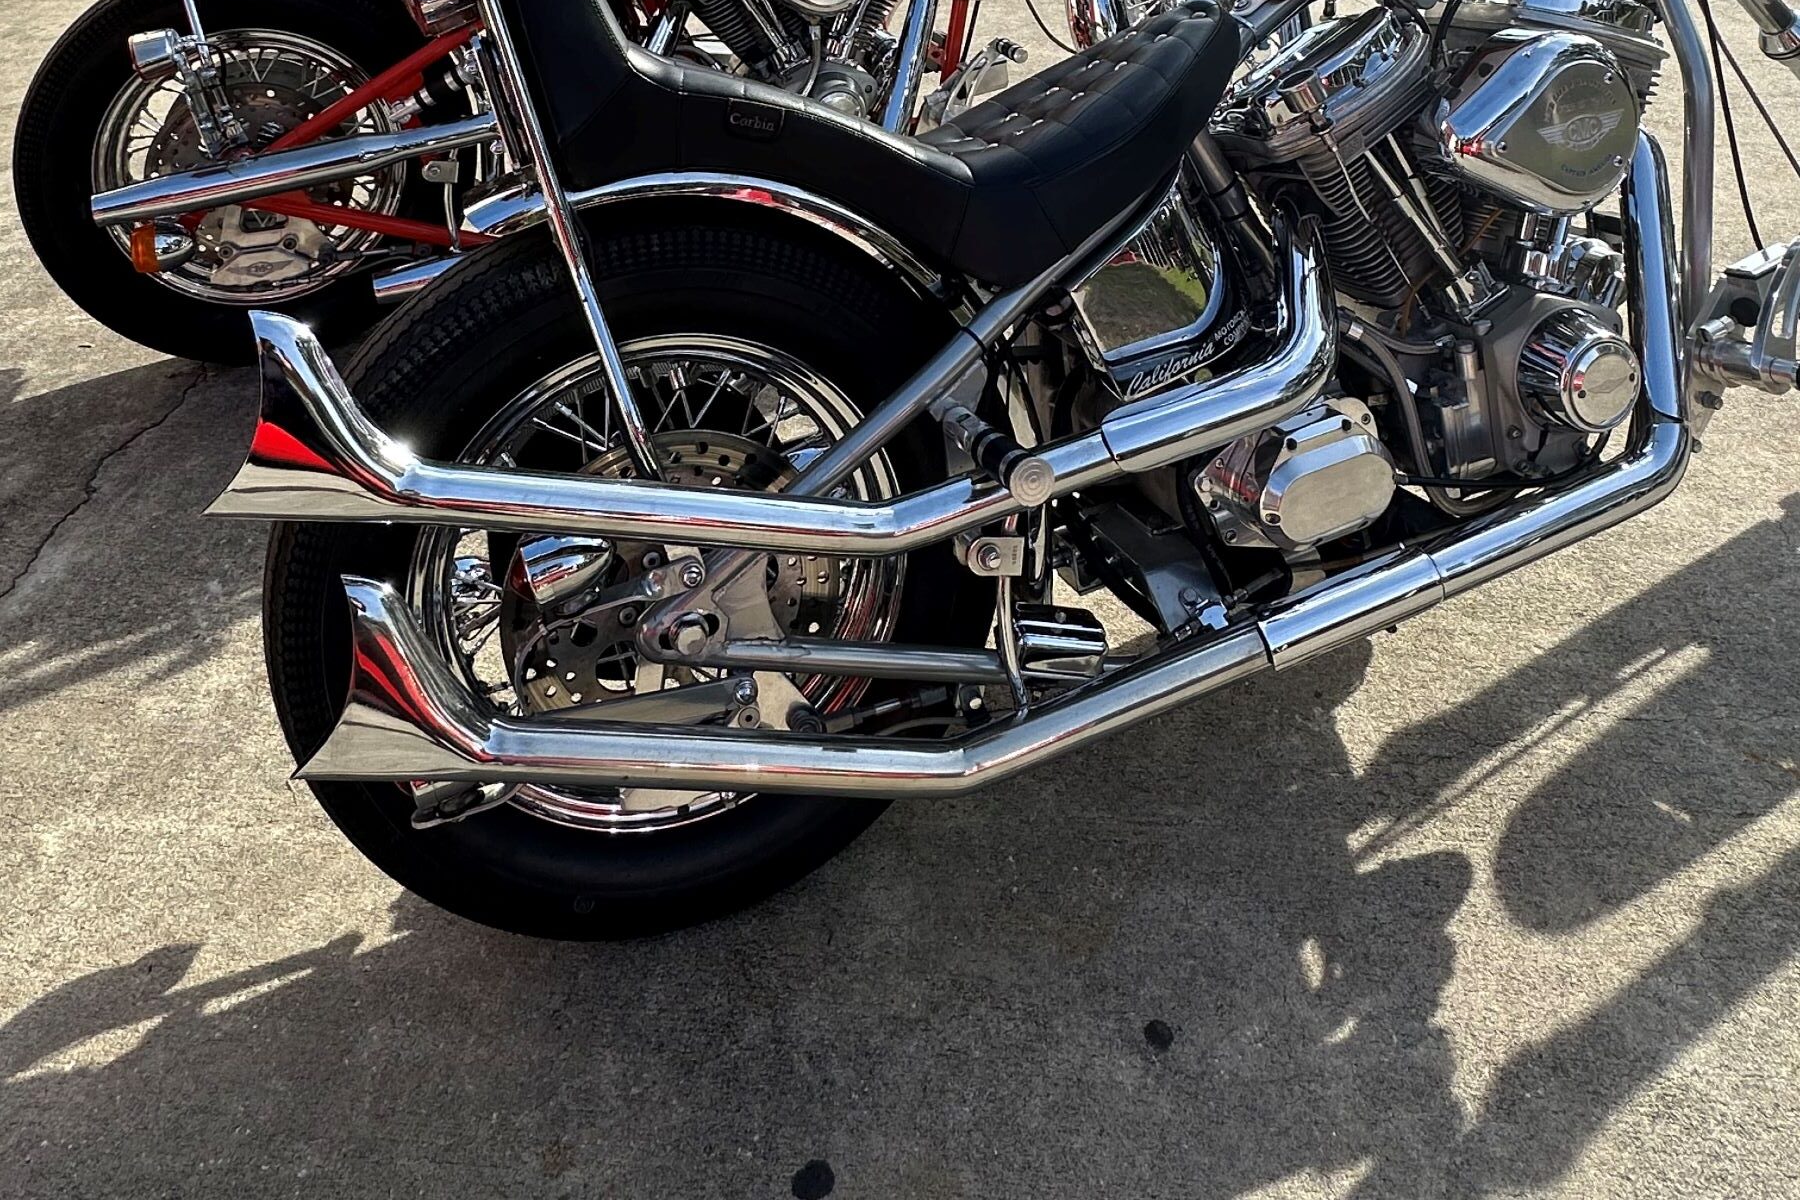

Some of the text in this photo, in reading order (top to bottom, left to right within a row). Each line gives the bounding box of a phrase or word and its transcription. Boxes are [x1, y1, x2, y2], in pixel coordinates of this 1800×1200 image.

[730, 112, 775, 132] Corbin
[1568, 117, 1599, 142] CMC
[1126, 341, 1216, 401] California
